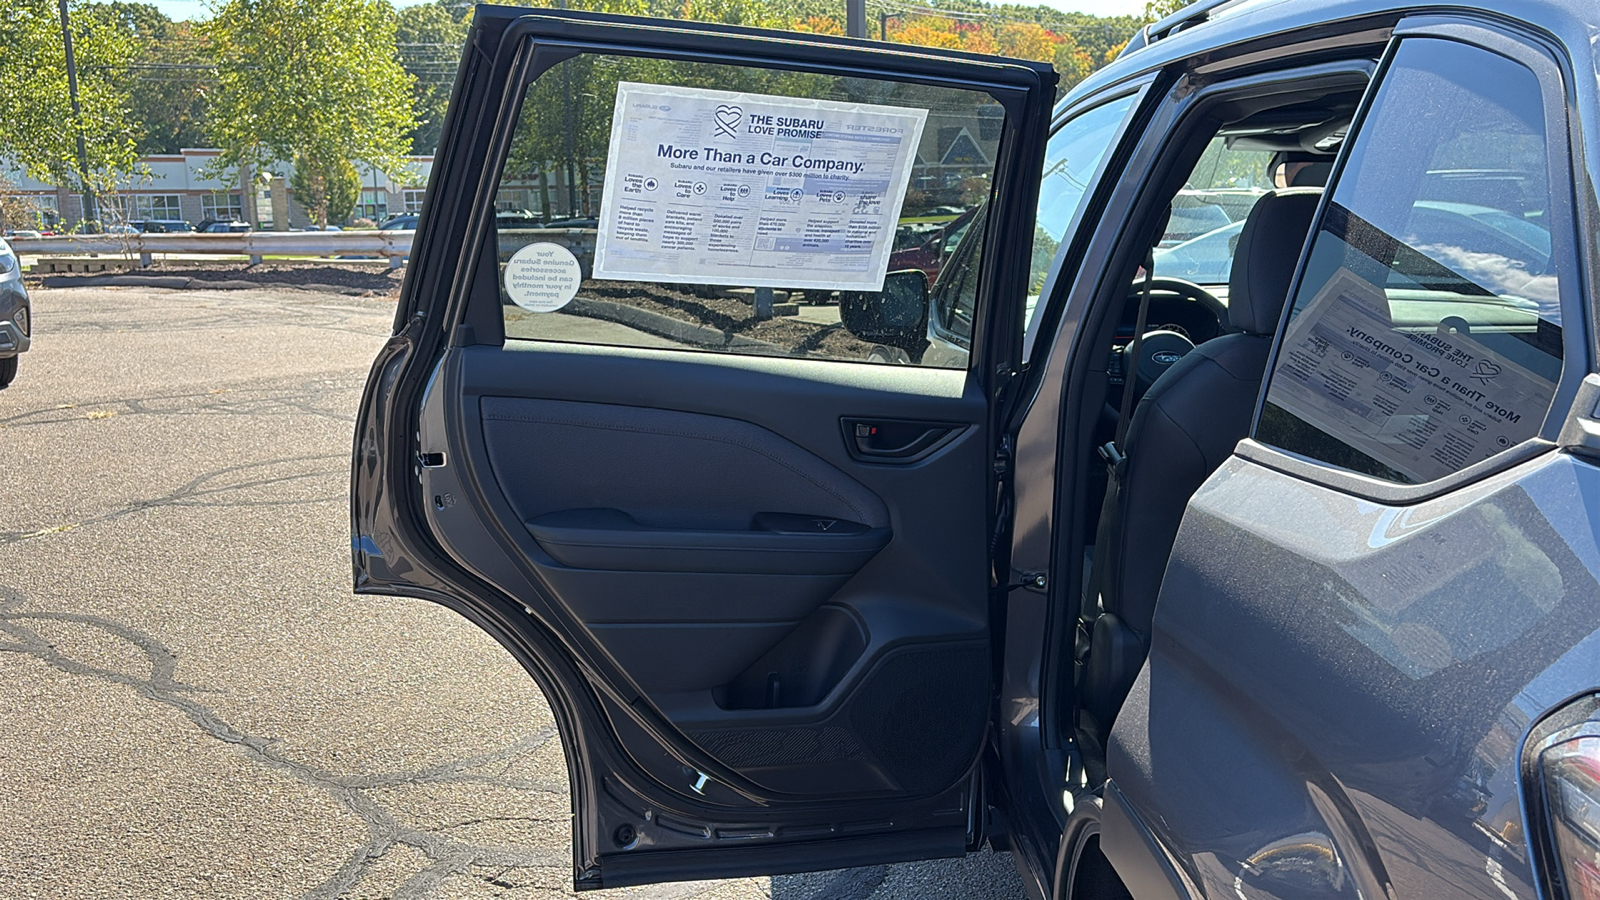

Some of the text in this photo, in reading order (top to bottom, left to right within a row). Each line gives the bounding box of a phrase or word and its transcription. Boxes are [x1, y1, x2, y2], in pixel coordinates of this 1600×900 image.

[750, 115, 824, 130] THE SUBARU
[748, 125, 822, 139] LOVE PROMISE
[657, 144, 699, 160] More
[703, 147, 742, 164] Than
[746, 154, 755, 165] a
[760, 152, 788, 167] Car
[670, 162, 692, 170] Subaru
[717, 165, 741, 174] retailers
